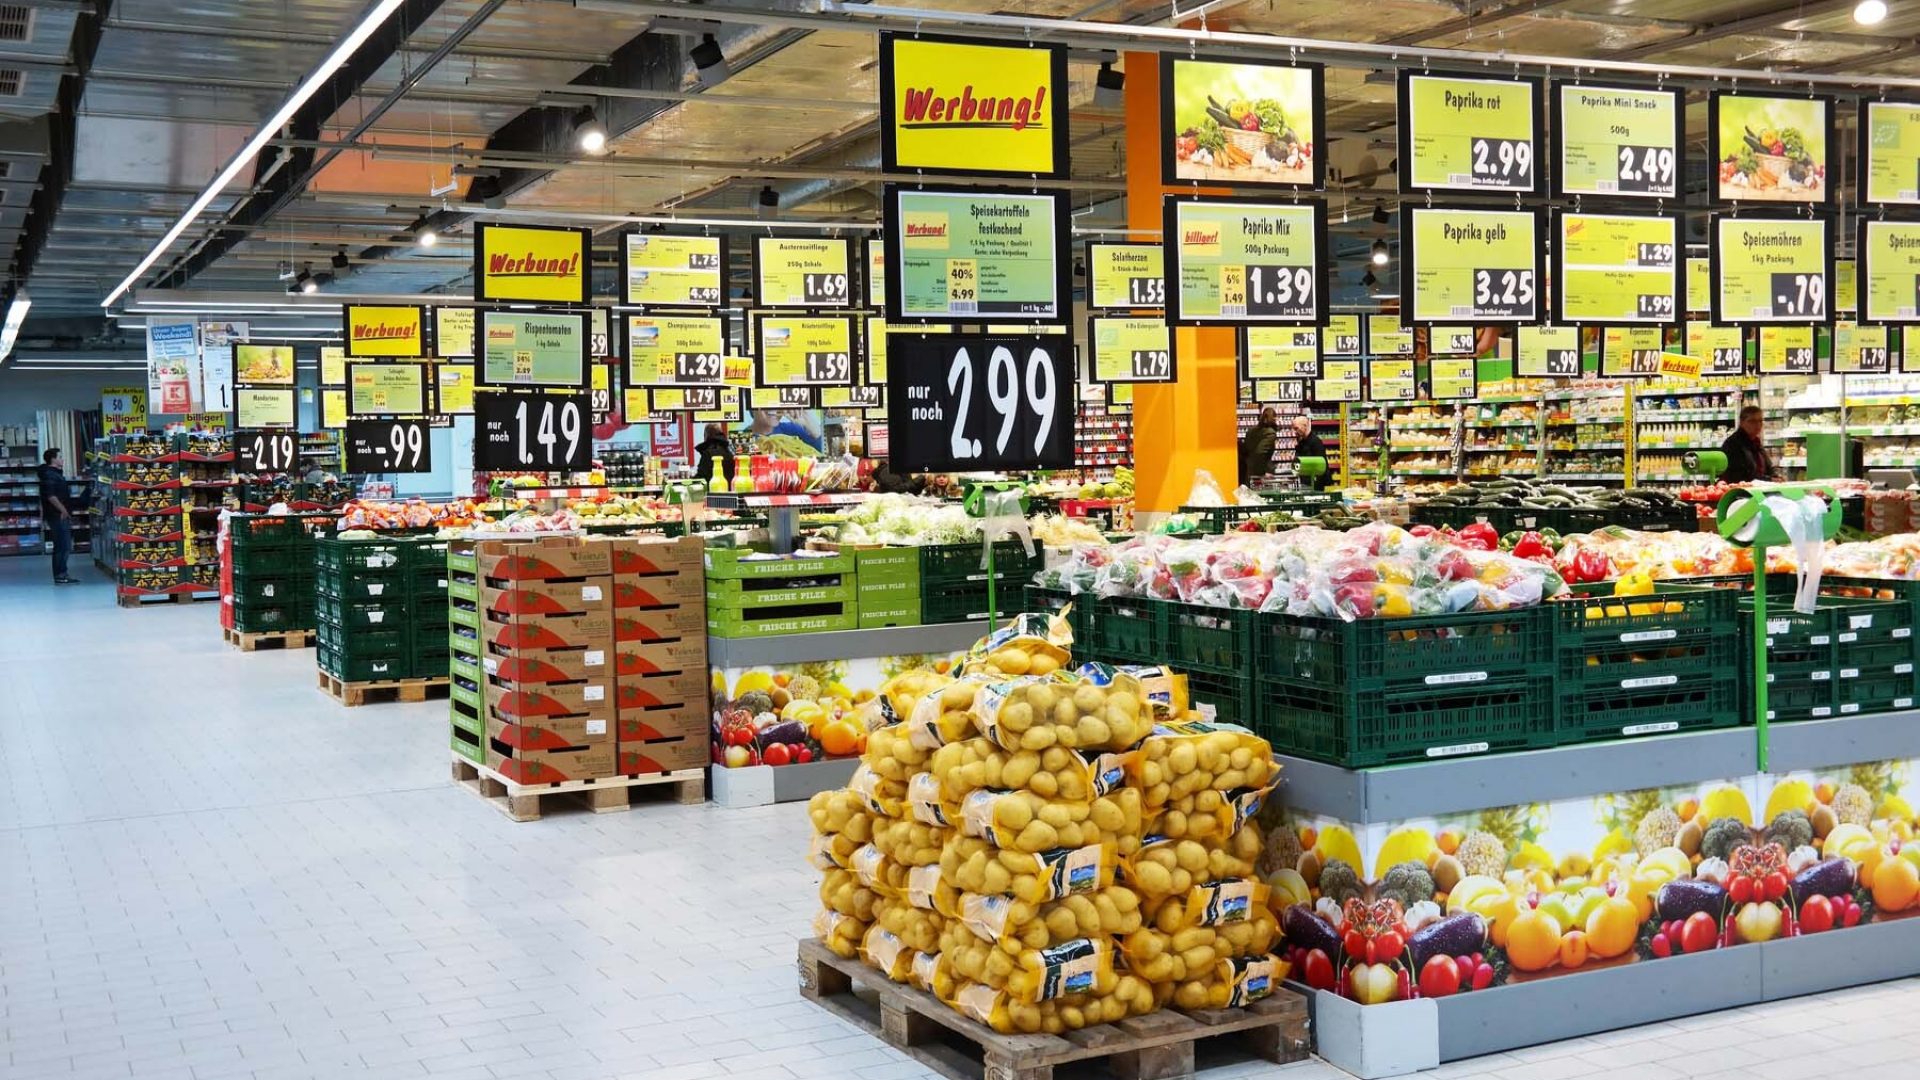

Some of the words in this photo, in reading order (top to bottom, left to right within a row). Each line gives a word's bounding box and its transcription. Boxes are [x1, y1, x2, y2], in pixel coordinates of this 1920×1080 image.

[904, 85, 1047, 131] Werbung!
[1445, 91, 1483, 112] Paprika
[1487, 96, 1501, 109] rot
[1582, 96, 1611, 108] Paprika
[1614, 98, 1632, 107] Mini
[1635, 99, 1657, 109] Snack
[1610, 125, 1630, 137] 500g
[1473, 139, 1531, 177] 2.99
[1619, 147, 1673, 183] 2.49
[970, 204, 1030, 219] Speisekartoffeln
[906, 224, 947, 235] Werbung!
[979, 222, 1023, 235] festkochend
[1243, 218, 1273, 239] Paprika
[1276, 219, 1291, 235] Mix
[1444, 223, 1482, 244] Paprika
[1486, 223, 1507, 244] gelb
[1184, 230, 1219, 244] billiger!
[1743, 231, 1802, 250] Speisemöhren
[779, 243, 828, 252] Austernseitlinge
[1245, 244, 1262, 256] 500g
[1263, 244, 1290, 256] Packung
[1639, 244, 1672, 260] 1.29
[489, 252, 579, 278] Werbung!
[691, 254, 718, 265] 1.75
[1111, 252, 1148, 263] Salatherzen
[1766, 254, 1794, 265] Packung
[951, 268, 974, 280] 40%
[1226, 274, 1240, 285] 6%
[806, 274, 846, 296] 1.69
[1132, 279, 1164, 303] 1.55
[1250, 267, 1312, 305] 1.39
[1476, 270, 1533, 305] 3.25
[690, 288, 718, 299] 4.49
[951, 289, 974, 300] 4.99
[1224, 293, 1244, 303] 1.49
[1777, 274, 1823, 315] -.79
[1639, 296, 1672, 312] 1.99
[354, 321, 417, 340] Werbung!
[525, 322, 572, 338] Rispentomaten
[1337, 337, 1358, 349] 1.99
[1452, 335, 1473, 348] 6.90
[678, 353, 719, 376] 1.29
[1134, 352, 1168, 376] 1.79
[1550, 351, 1577, 373] -.99
[1633, 351, 1659, 372] 1.49
[1714, 349, 1740, 366] 2.49
[1788, 349, 1811, 365] -.89
[1861, 349, 1884, 365] 1.79
[809, 353, 848, 379] 1.59
[1662, 360, 1699, 374] Werbung!
[685, 389, 713, 403] 1.79
[781, 388, 809, 401] 1.99
[851, 387, 877, 401] 1.99
[908, 386, 931, 399] nur
[1279, 382, 1302, 399] 1.49
[112, 398, 123, 411] 50
[947, 345, 1056, 459] 2.99
[187, 413, 223, 423] billiger!
[911, 401, 943, 420] noch
[105, 414, 144, 424] billiger!
[487, 421, 502, 430] nur
[489, 430, 510, 442] noch
[515, 400, 580, 464] 1.49
[375, 424, 422, 468] -.99
[754, 563, 794, 573] FRISCHE
[797, 562, 824, 571] PILZE
[758, 592, 798, 602] FRISCHE
[801, 591, 826, 600] PILZE
[759, 622, 798, 632] FRISCHE
[801, 620, 827, 629] PILZE
